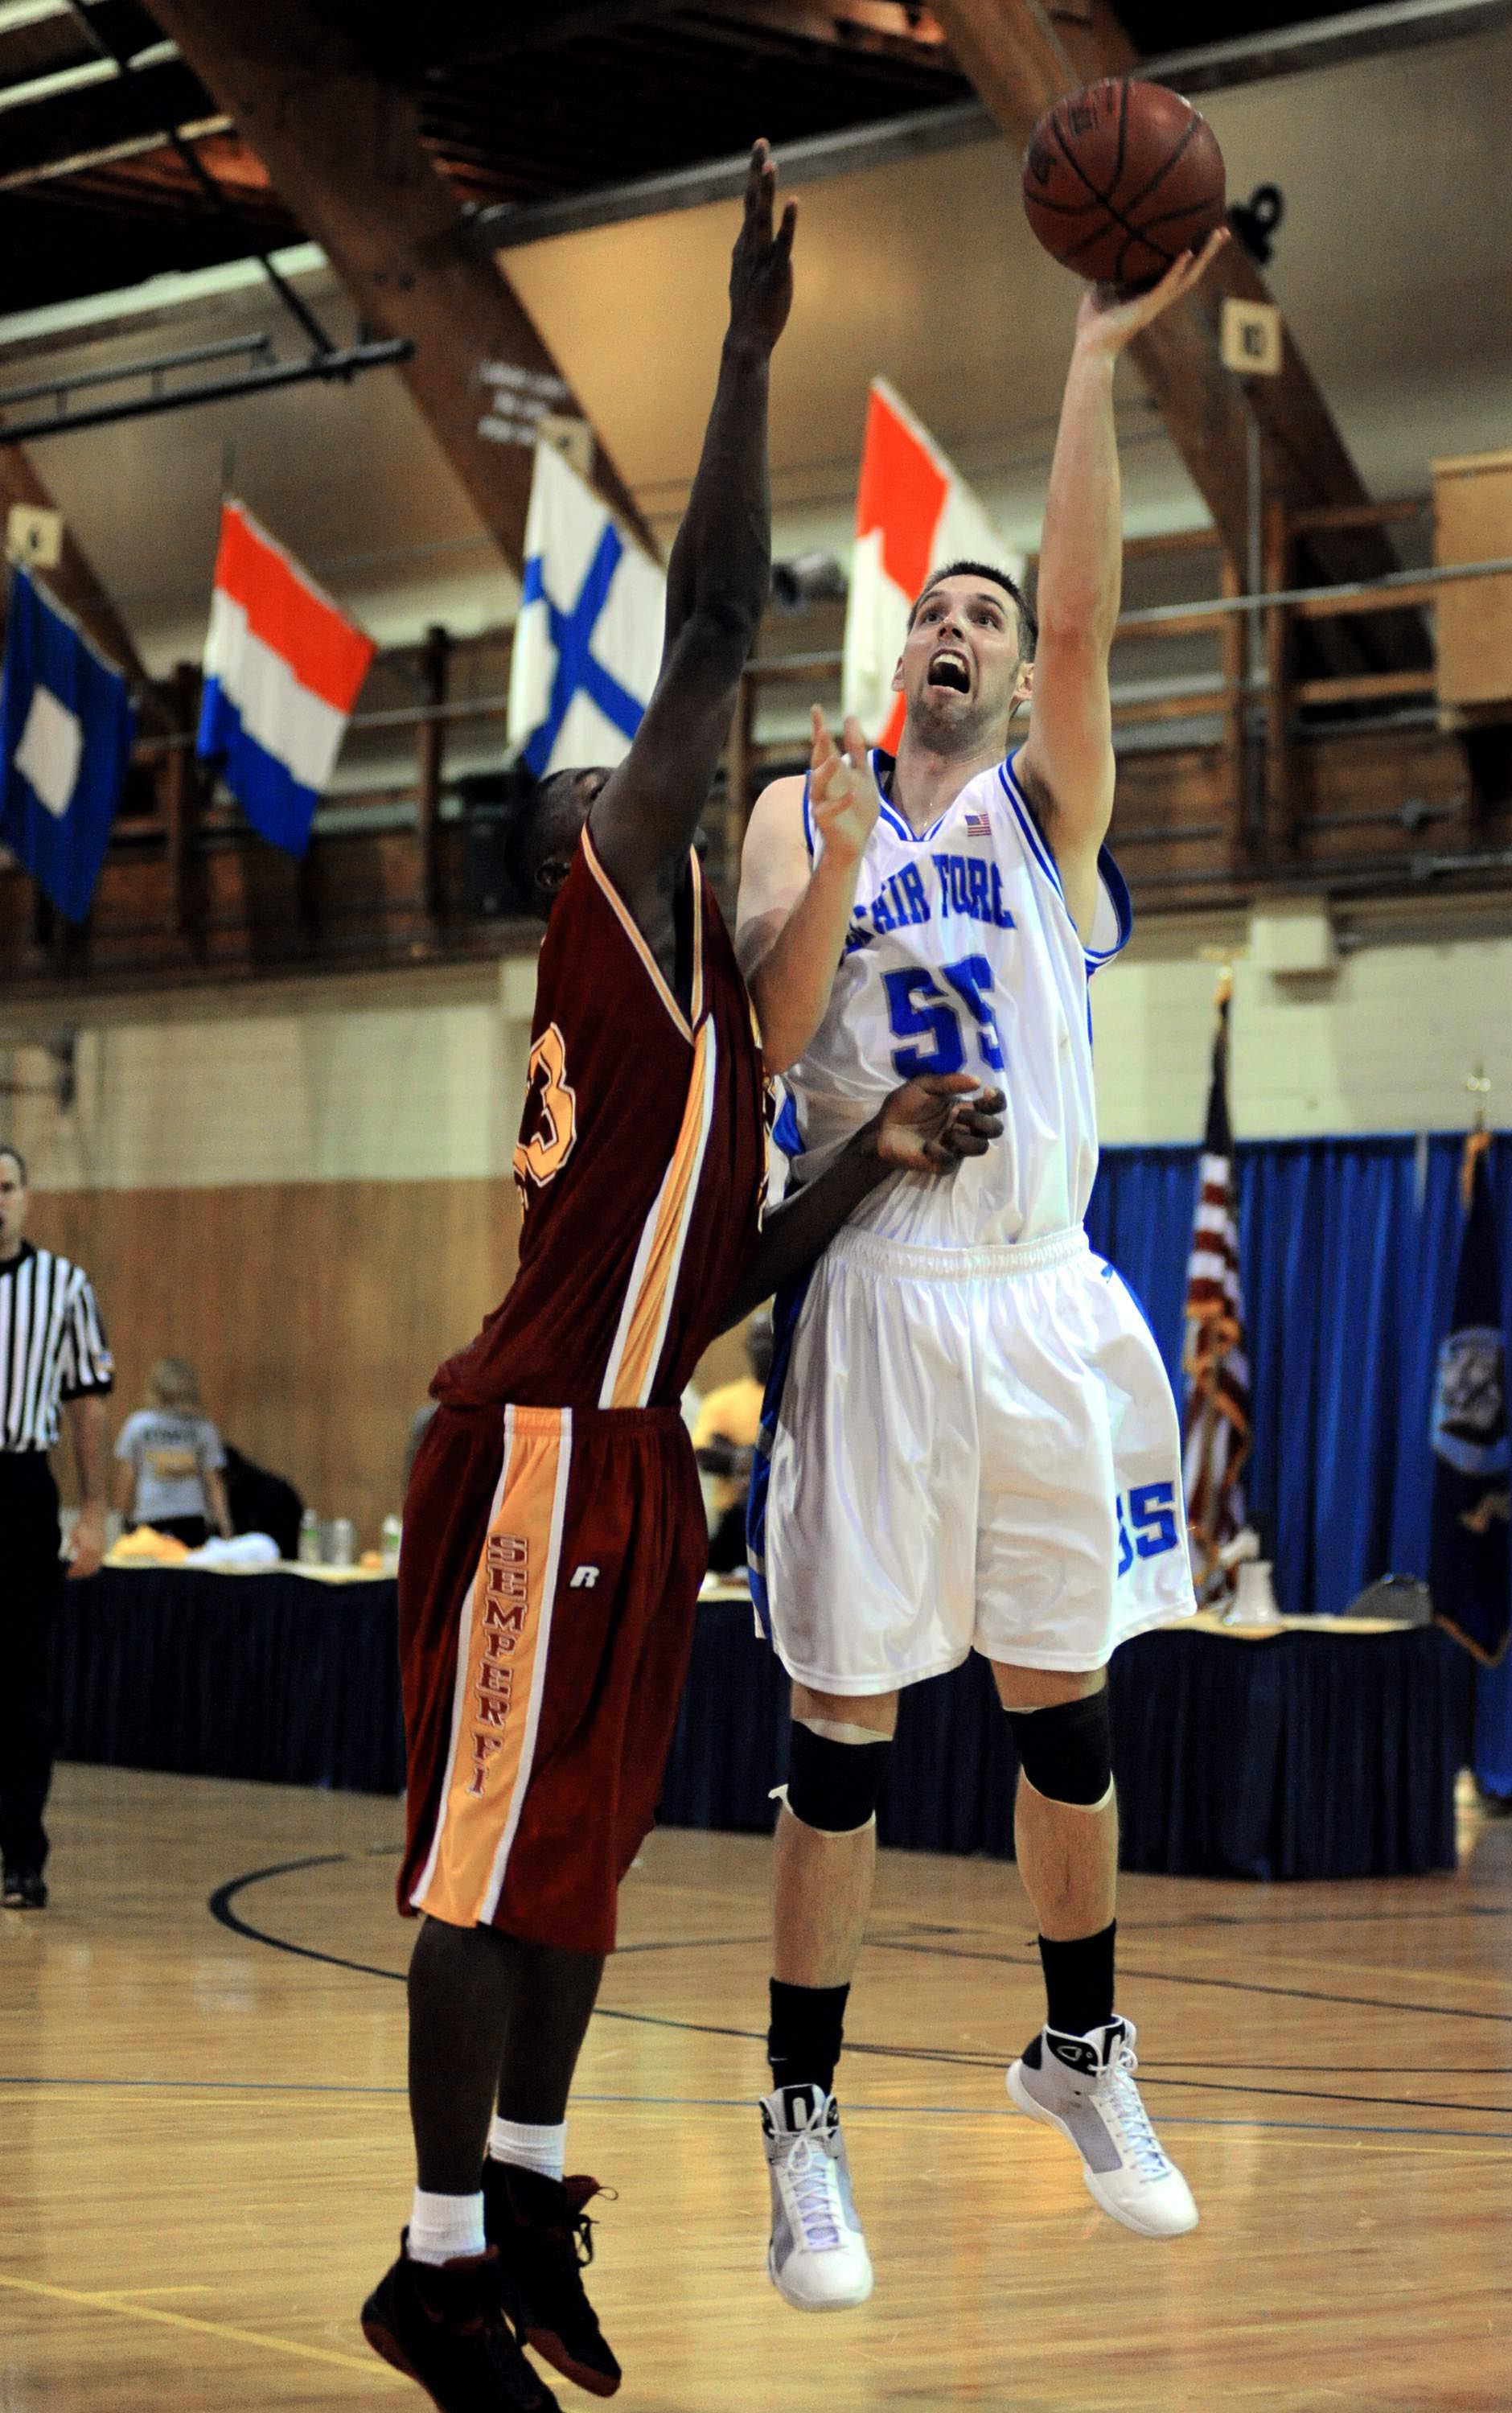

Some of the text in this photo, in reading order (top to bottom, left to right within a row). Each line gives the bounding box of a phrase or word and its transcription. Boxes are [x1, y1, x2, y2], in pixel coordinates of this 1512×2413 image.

[871, 861, 931, 935] AIR
[880, 953, 1005, 1079] 55
[569, 1565, 600, 1589] R
[466, 1533, 528, 1799] SEMPER FI
